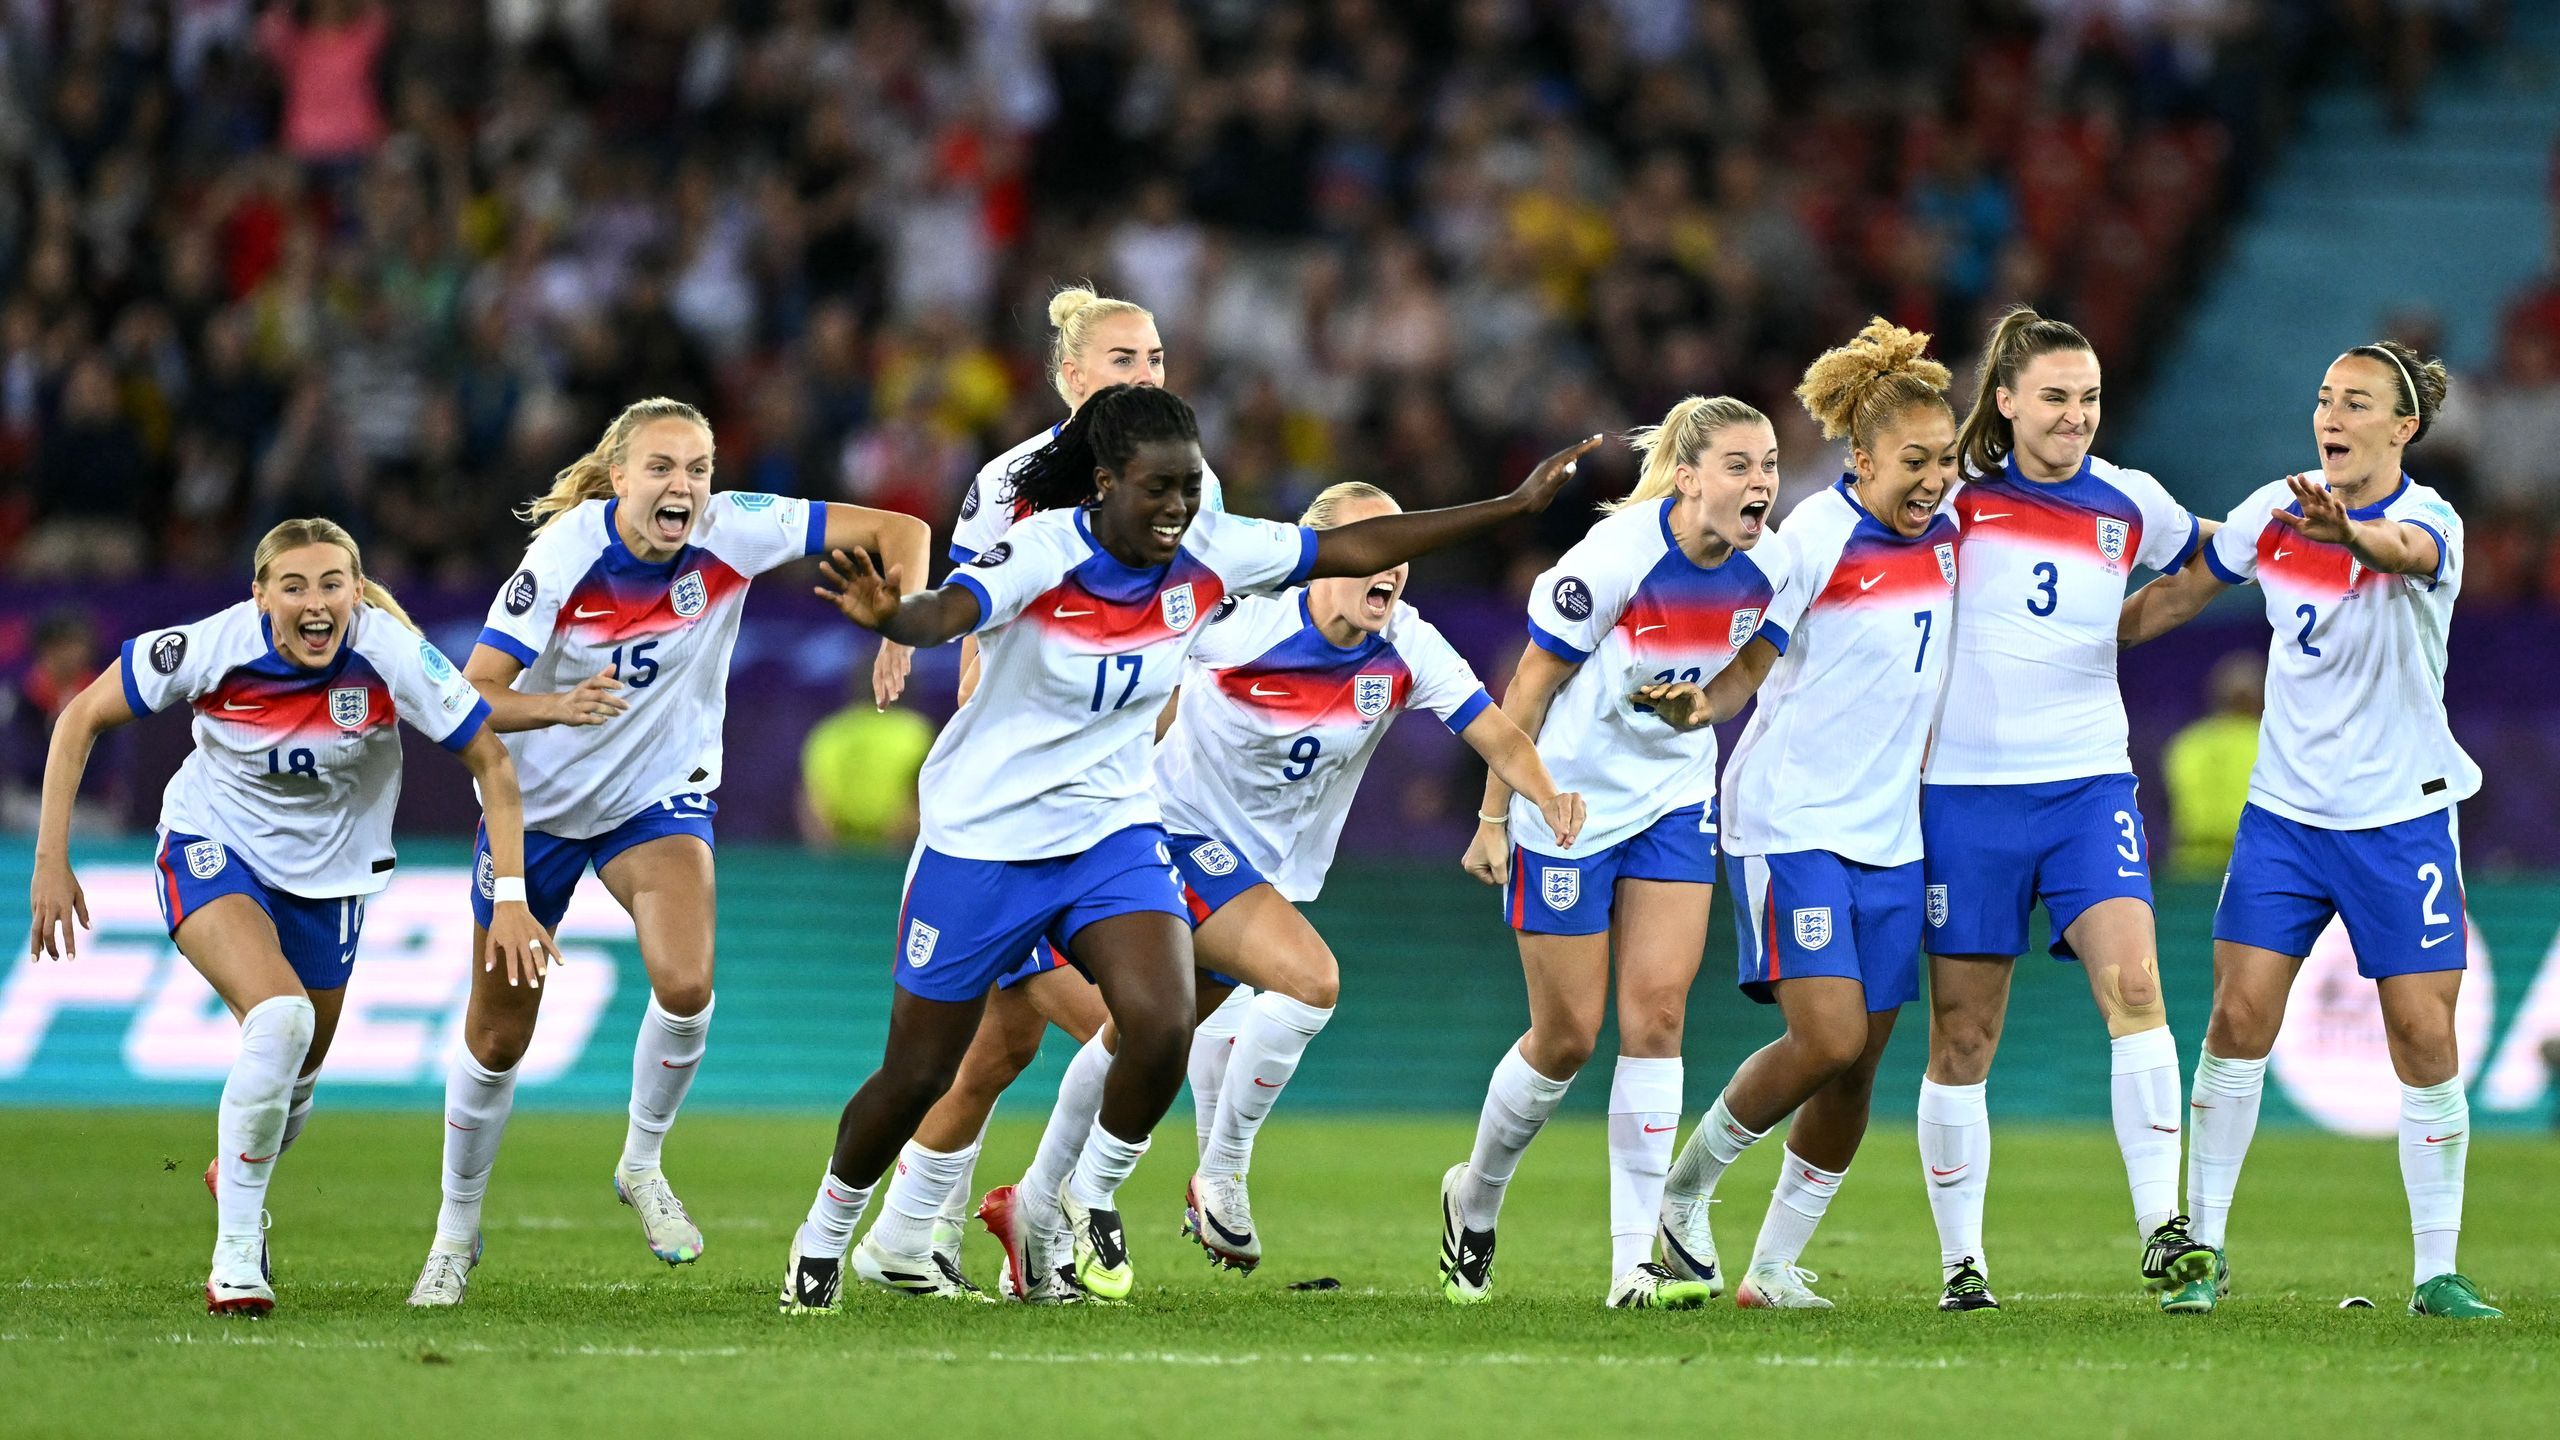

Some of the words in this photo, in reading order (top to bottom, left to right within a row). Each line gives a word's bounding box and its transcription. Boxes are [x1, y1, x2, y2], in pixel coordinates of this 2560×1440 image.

[2026, 561, 2059, 617] 3
[1912, 610, 1932, 673] 7
[2295, 602, 2322, 658] 2
[611, 640, 660, 689] 15
[1090, 654, 1144, 712] 17
[268, 747, 319, 782] 18
[1282, 735, 1321, 782] 9
[2113, 809, 2140, 864] 3
[2416, 861, 2451, 926] 2
